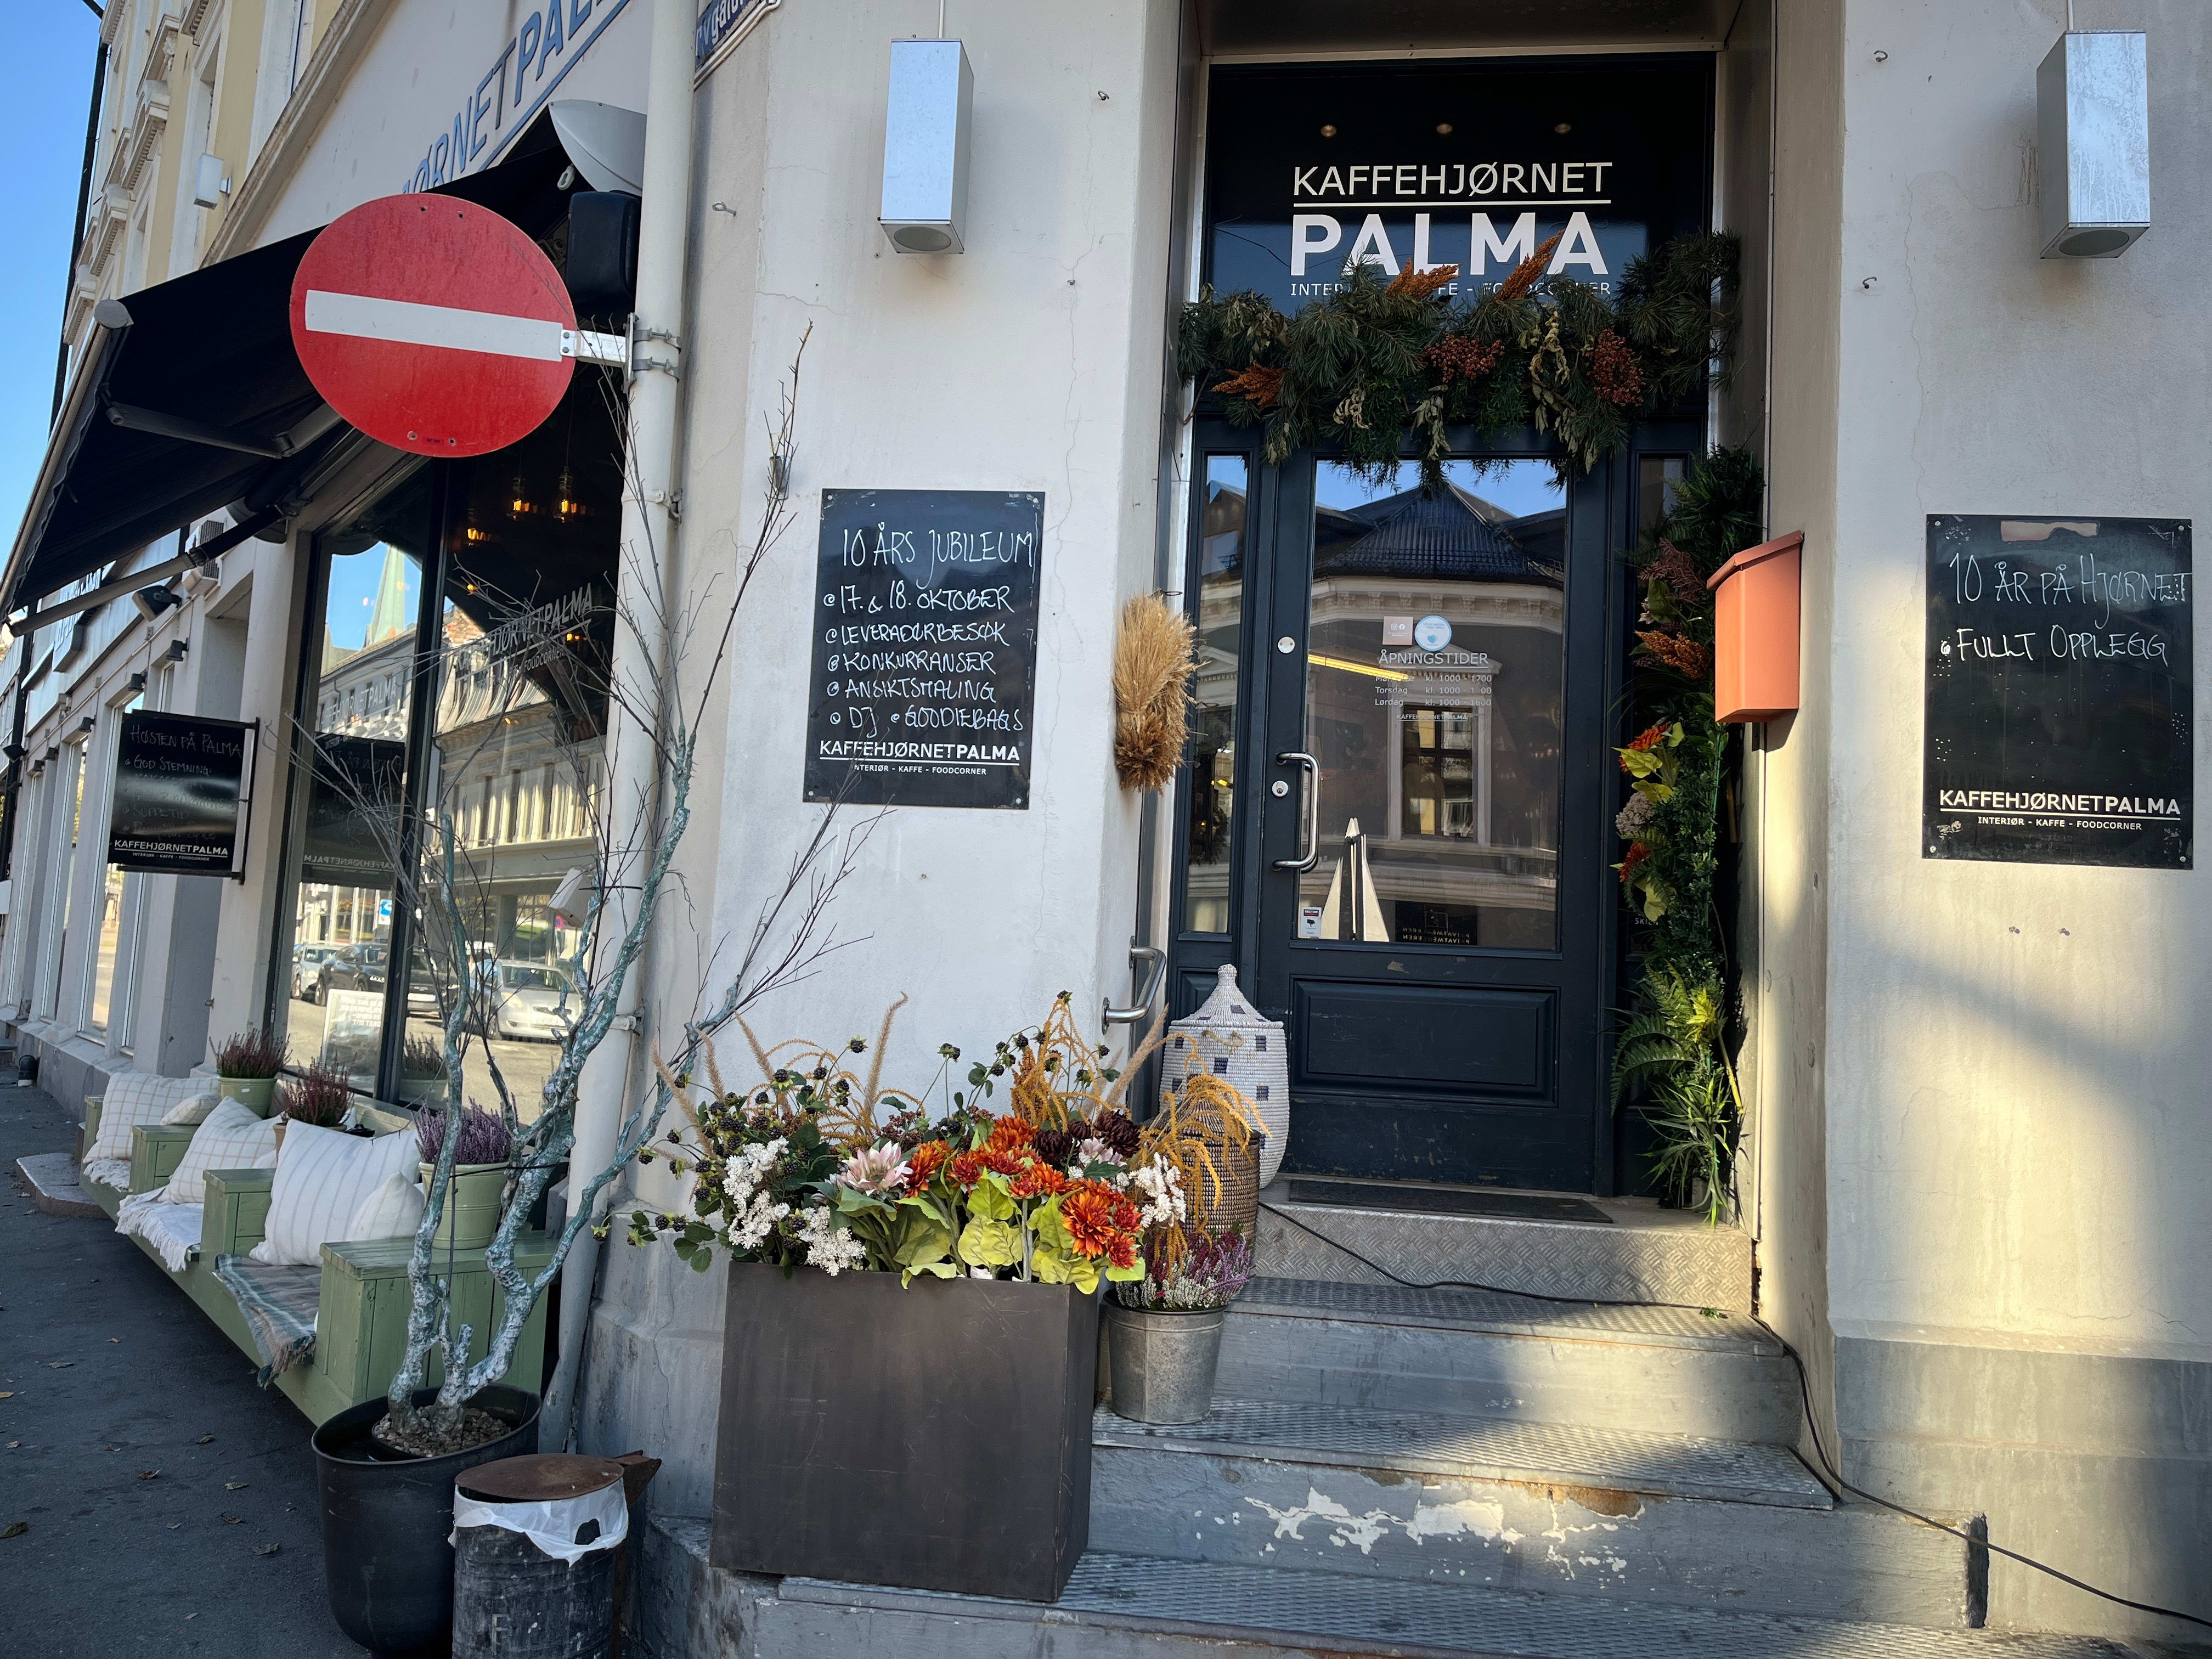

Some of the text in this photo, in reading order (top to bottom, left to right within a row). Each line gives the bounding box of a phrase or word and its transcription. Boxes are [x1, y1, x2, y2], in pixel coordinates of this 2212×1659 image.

[1293, 161, 1612, 196] KAFFEHJØRNET
[1290, 211, 1609, 276] PALMA
[843, 521, 1033, 589] 10 ÅRS JUBILEUM
[917, 585, 1015, 613] OKTOBER
[1950, 552, 2192, 629] 10 ÅR PÅ HJØRNET
[1379, 649, 1488, 664] ÅPNINGSTIDER
[1957, 625, 2168, 667] FULLT OPPLEGG
[843, 650, 996, 675] KONKURRANSER
[845, 678, 996, 702] ANSIKTSMALING
[1375, 686, 1408, 695] Torsdag
[1375, 698, 1403, 707] Lørdag
[849, 706, 878, 738] DJ
[130, 724, 242, 758] HØSTEN PÅ PALMA
[134, 754, 156, 769] GOD
[853, 764, 889, 772] NTERIØR
[932, 767, 986, 775] FOODCORNER
[1978, 816, 2024, 826] INTERIØR
[2036, 819, 2066, 827] KAFFE
[2076, 820, 2142, 831] FOODCORNER
